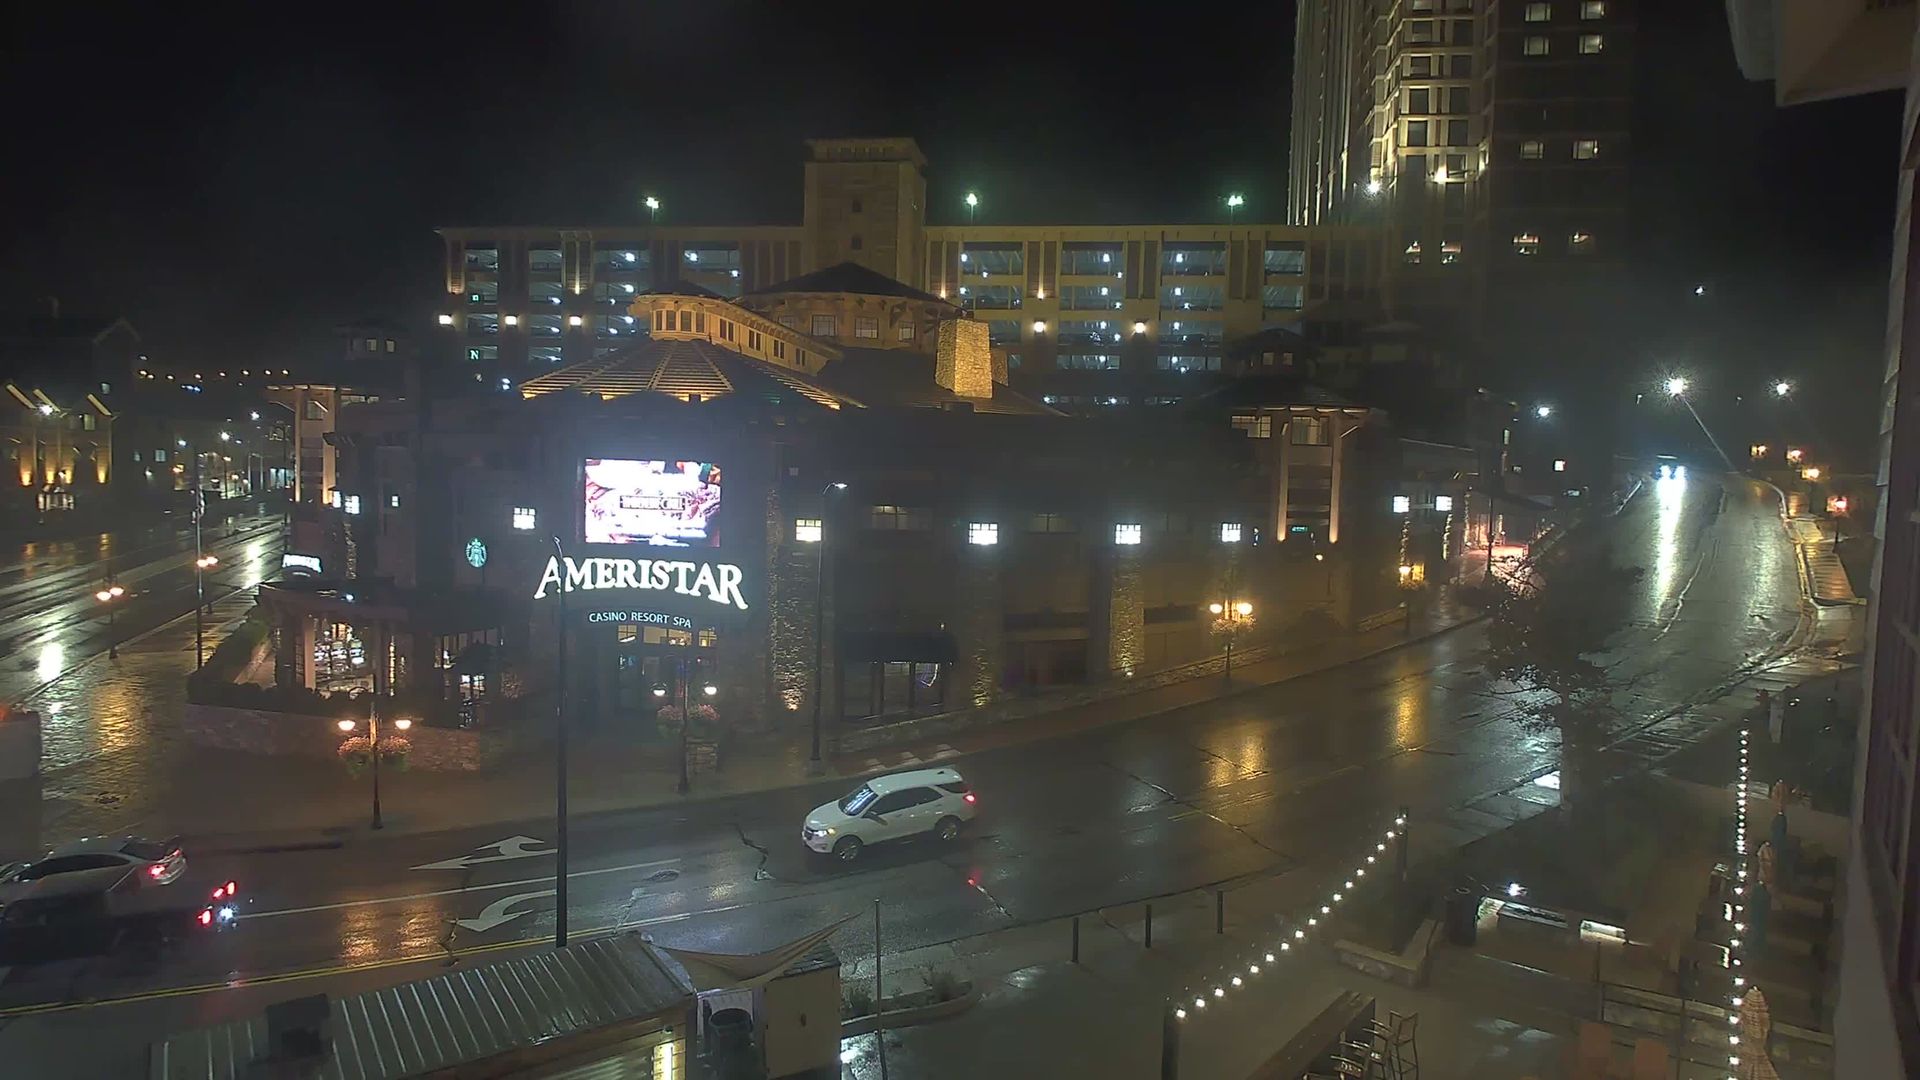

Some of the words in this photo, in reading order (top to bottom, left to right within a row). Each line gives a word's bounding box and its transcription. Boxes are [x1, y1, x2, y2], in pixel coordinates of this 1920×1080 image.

[534, 556, 748, 609] AMERISTAR
[589, 611, 627, 623] CASINO
[631, 612, 669, 624] RESORT
[673, 616, 692, 628] SPA
